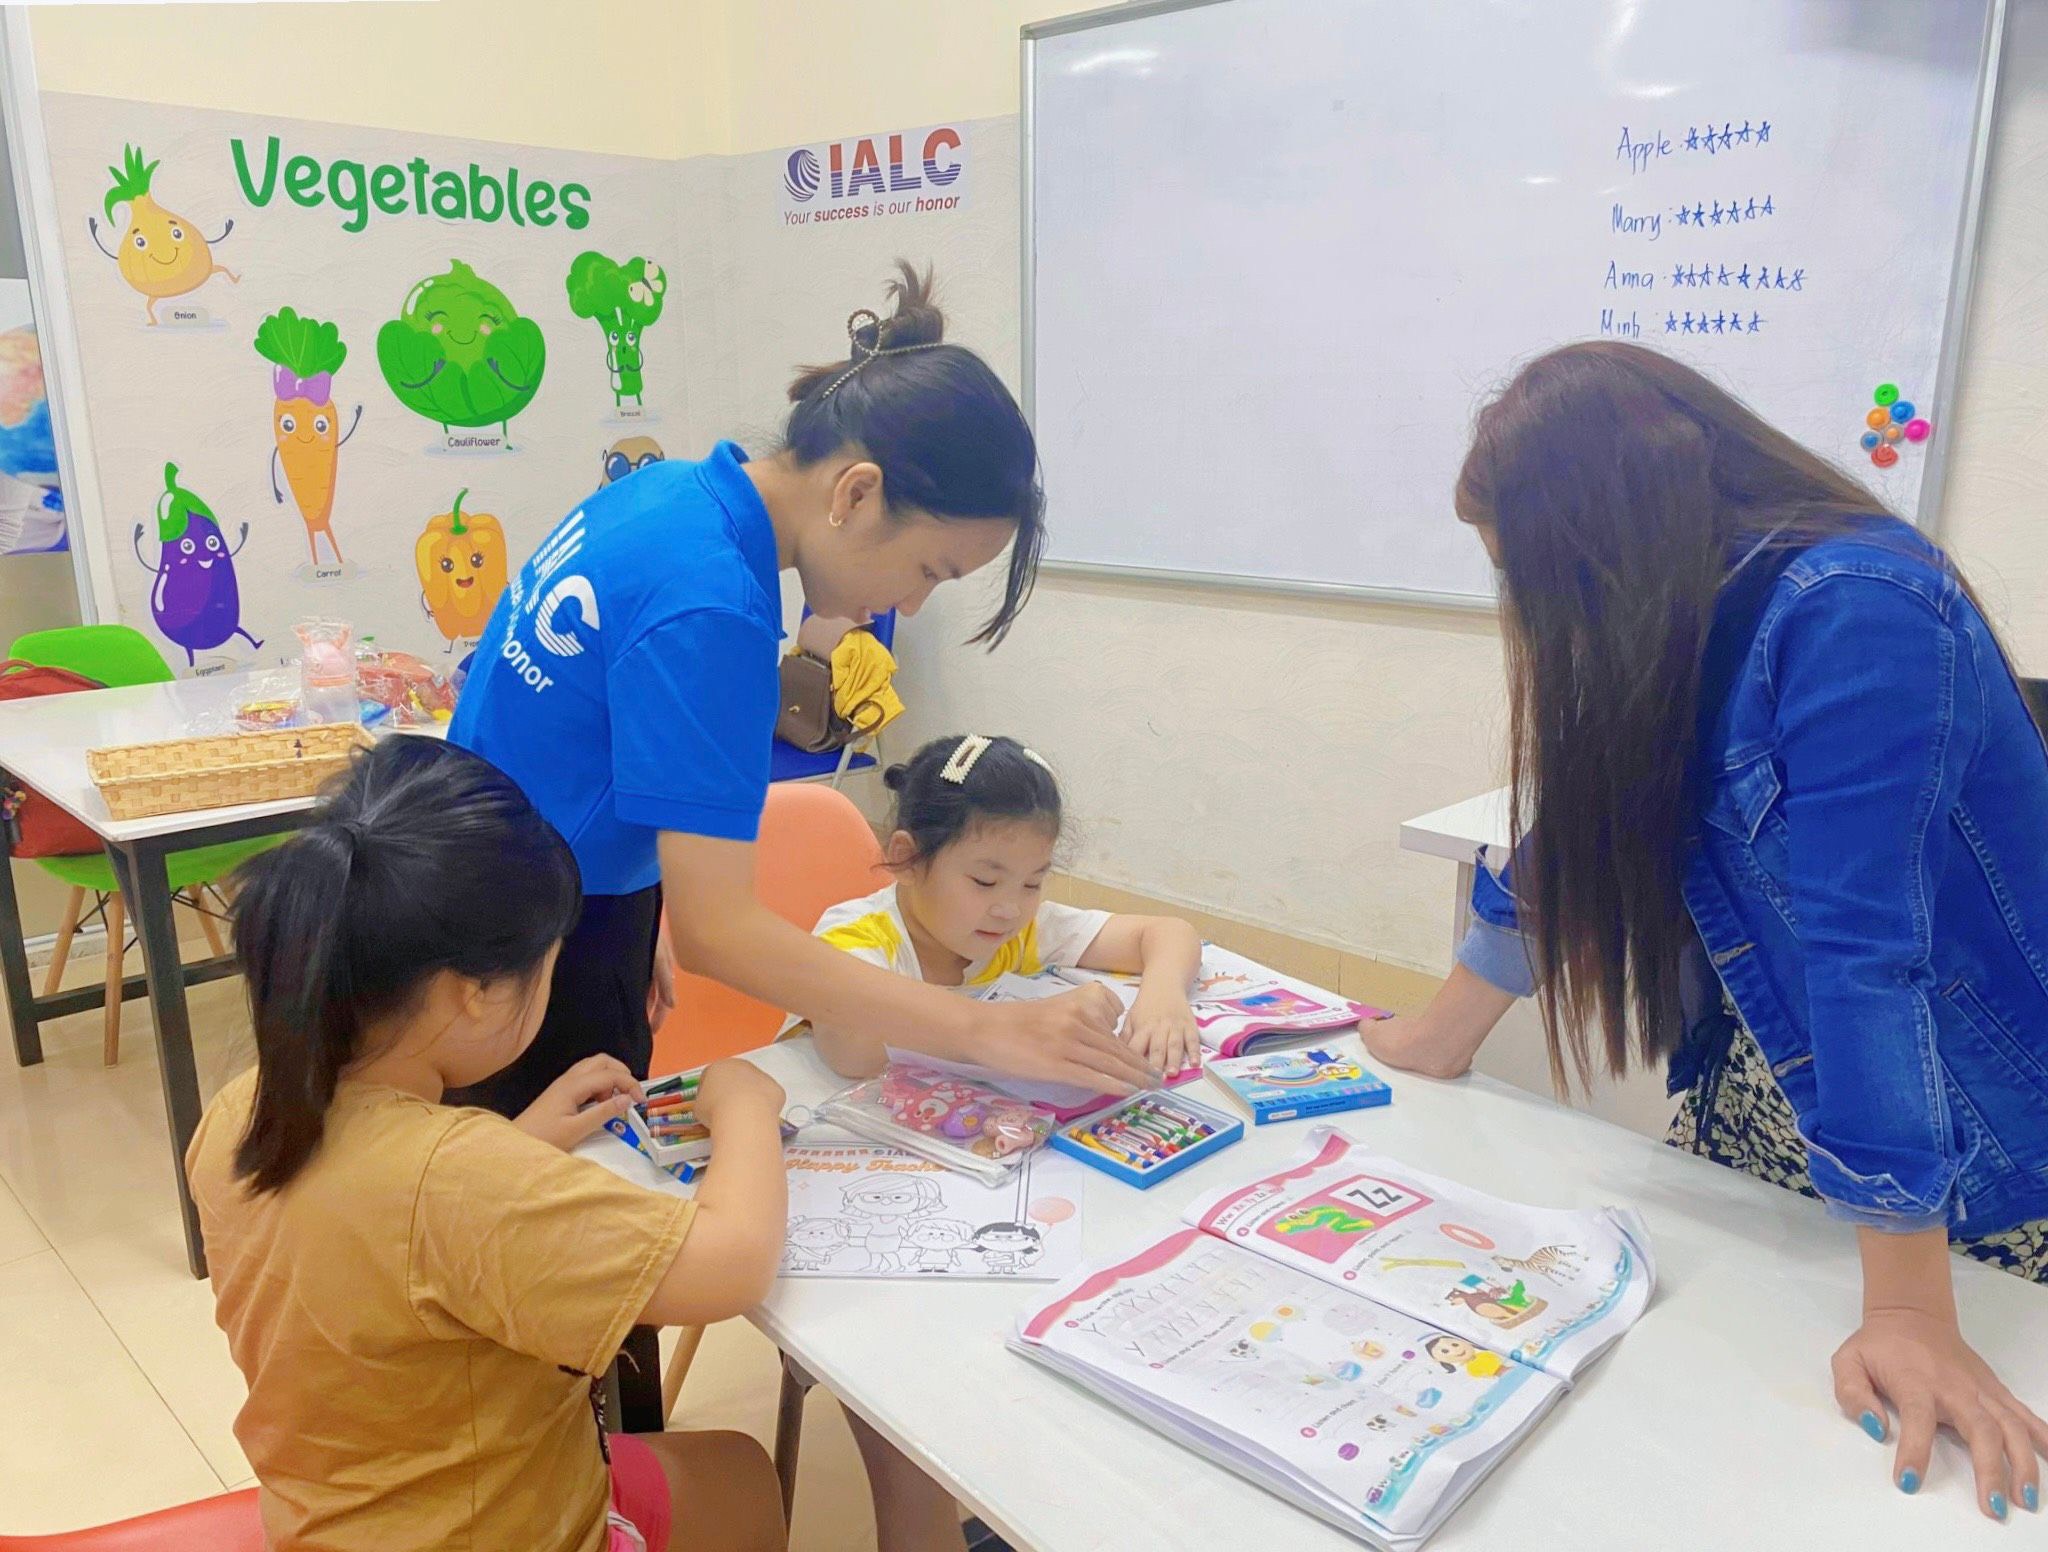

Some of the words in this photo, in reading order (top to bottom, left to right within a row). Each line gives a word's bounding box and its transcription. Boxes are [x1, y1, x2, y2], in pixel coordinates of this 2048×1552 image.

[830, 128, 961, 198] IALC
[1616, 126, 1674, 176] Apple
[230, 136, 592, 233] Vegetables
[784, 211, 809, 225] Your
[814, 204, 869, 223] success
[873, 201, 884, 217] is
[889, 199, 912, 215] our
[915, 196, 960, 213] honor
[1612, 203, 1662, 241] Marry
[1604, 260, 1654, 289] Anna
[174, 311, 197, 320] Onion
[448, 436, 501, 448] Cauliflower
[316, 568, 342, 578] Carrot
[786, 1159, 860, 1173] Happy
[1346, 1186, 1403, 1210] Zz
